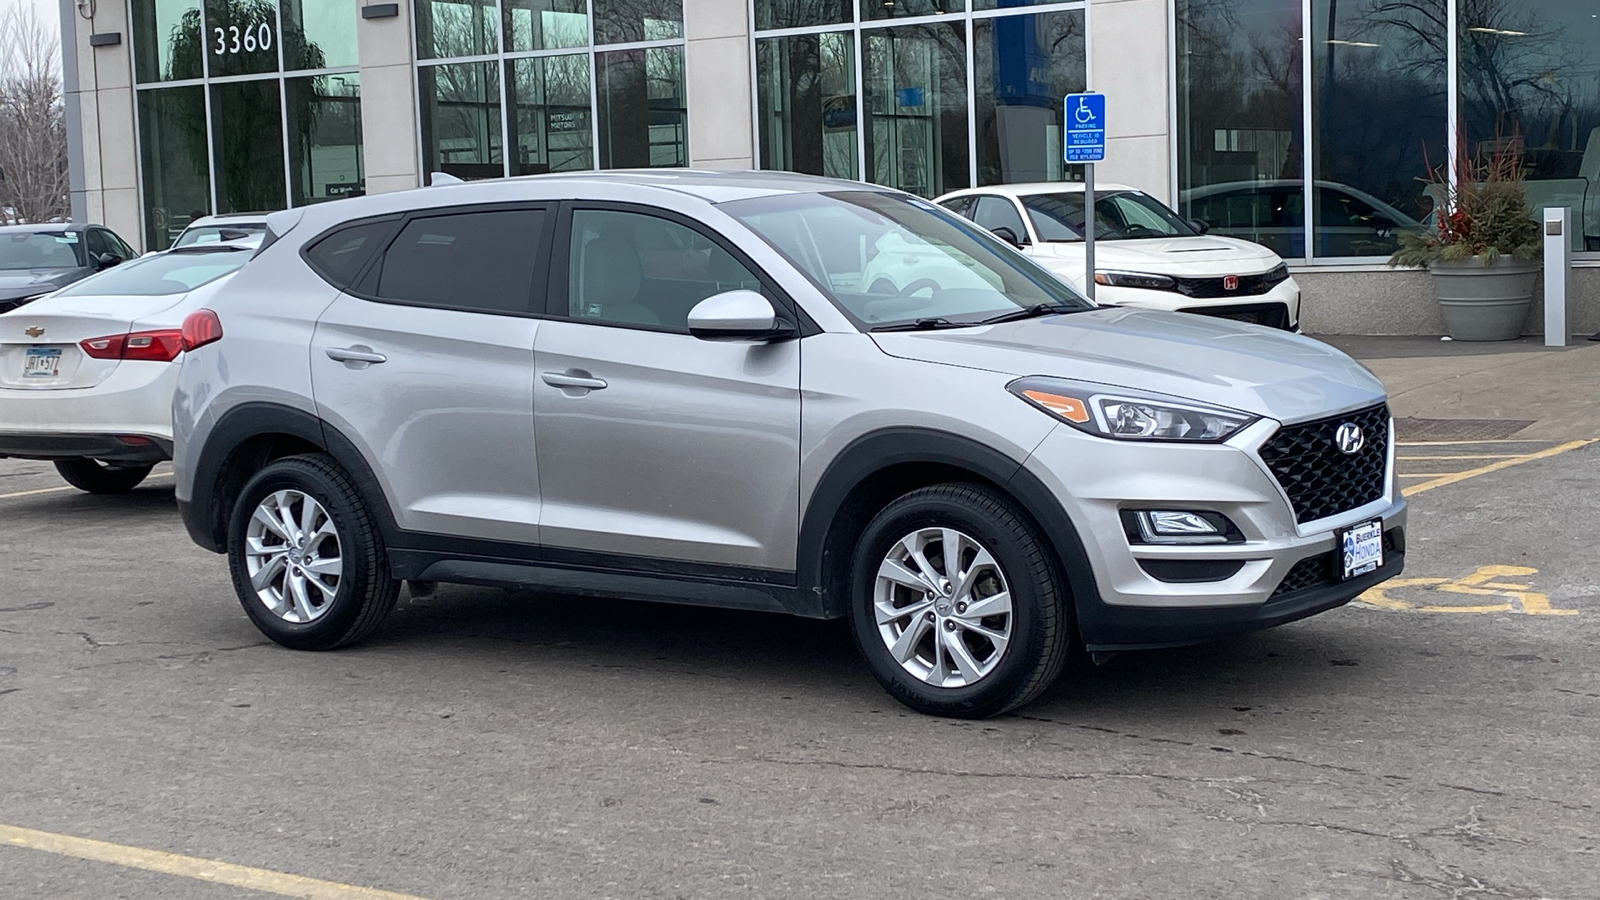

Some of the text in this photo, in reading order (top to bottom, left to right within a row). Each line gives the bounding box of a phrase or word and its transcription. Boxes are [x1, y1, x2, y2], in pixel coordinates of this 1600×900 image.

[214, 22, 271, 55] 3360
[1356, 528, 1380, 544] BUERKLE
[1355, 541, 1381, 562] HONDA
